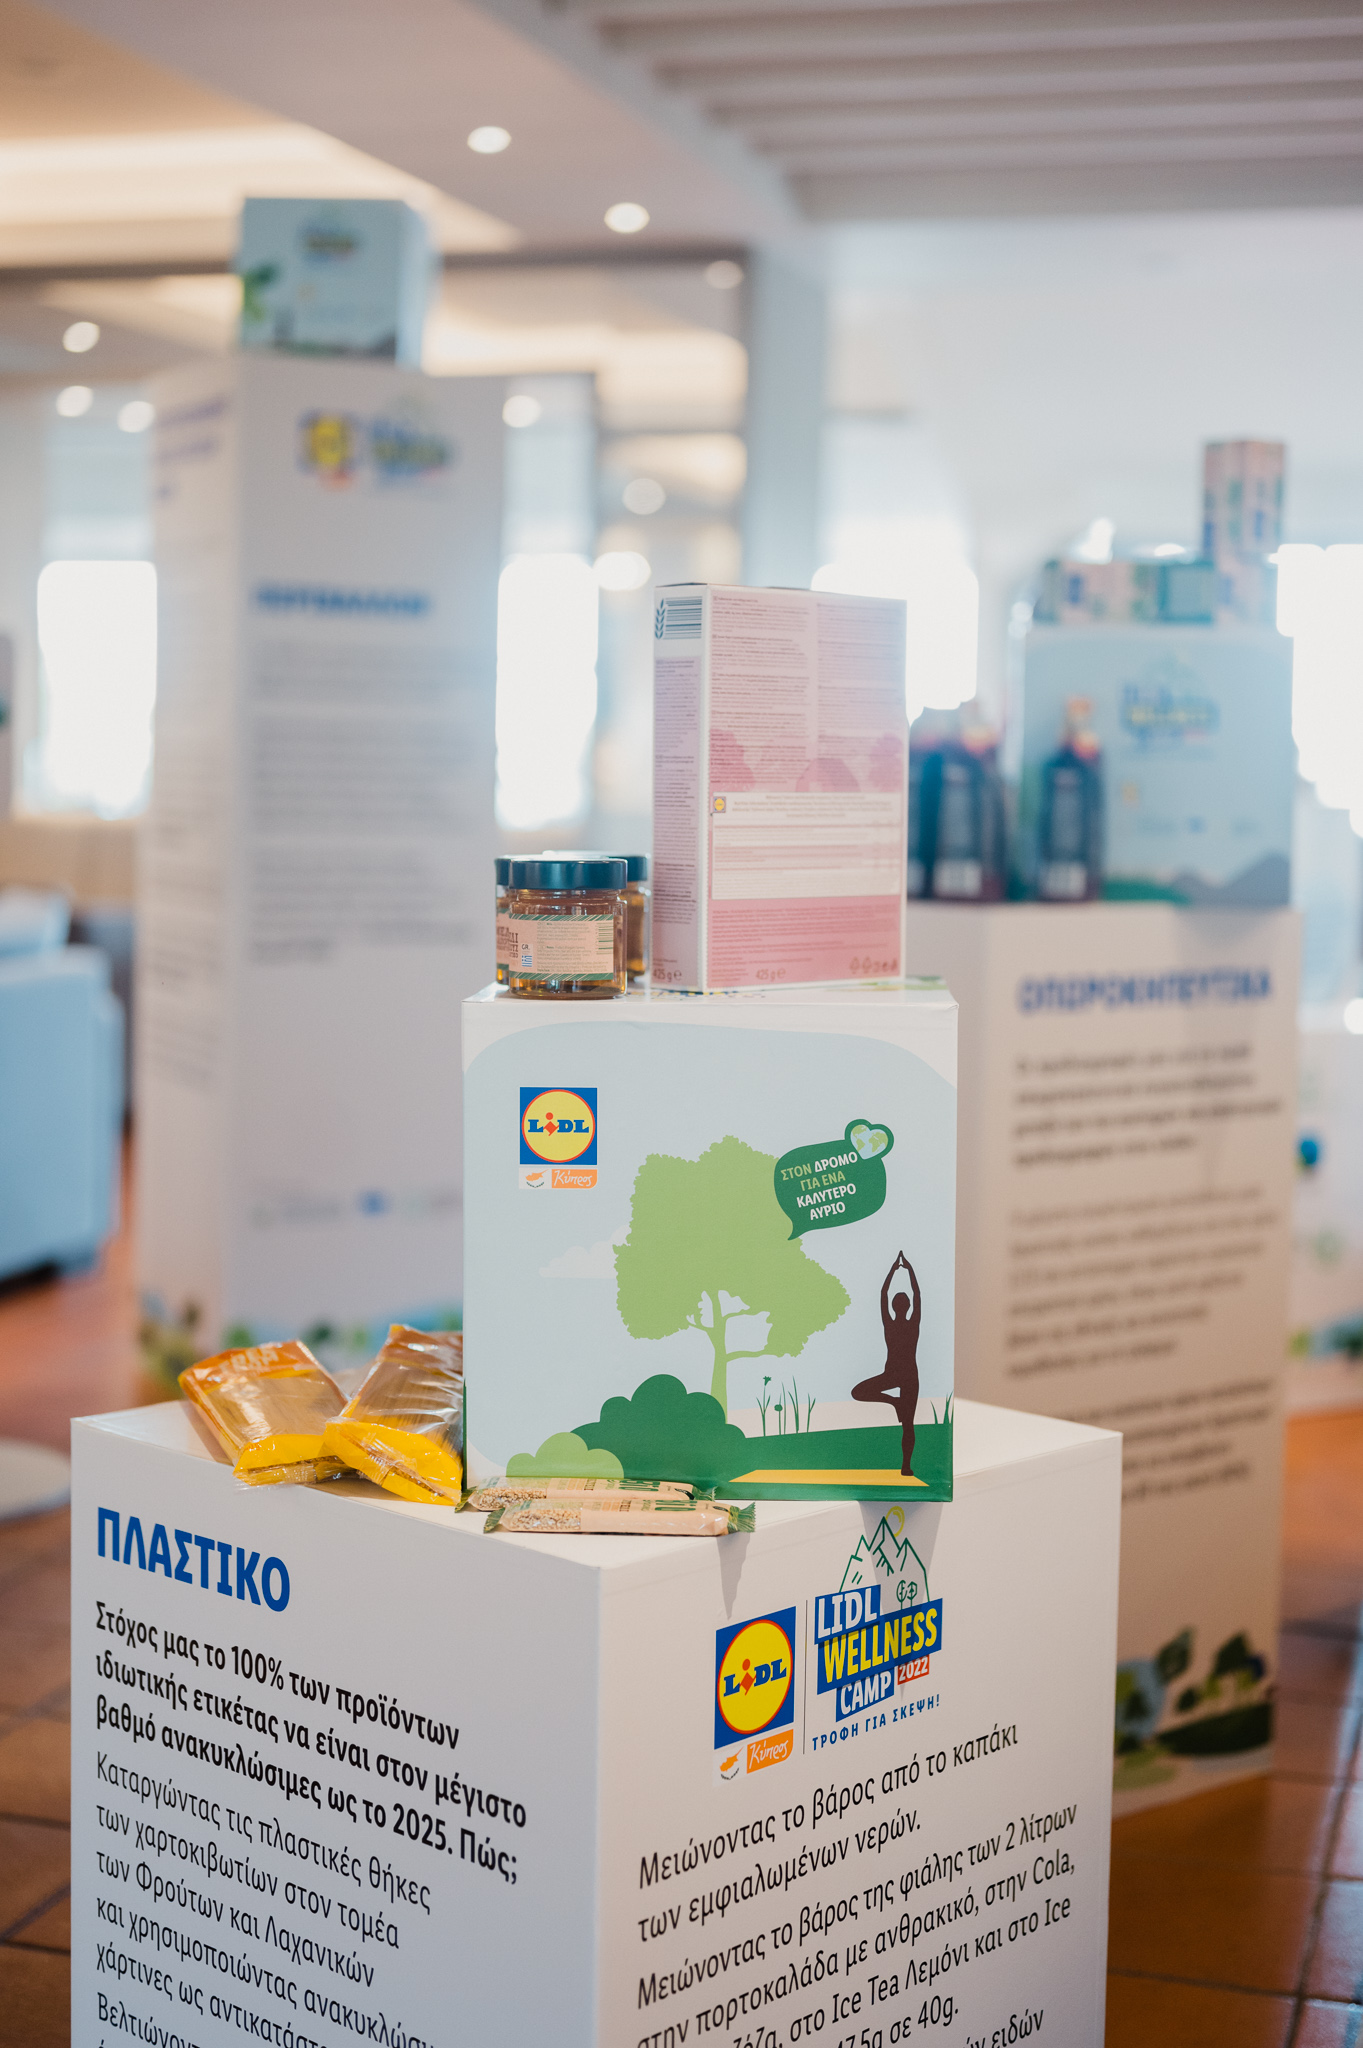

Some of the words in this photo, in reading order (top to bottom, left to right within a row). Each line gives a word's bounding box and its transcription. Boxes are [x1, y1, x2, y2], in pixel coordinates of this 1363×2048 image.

[553, 1170, 593, 1187] Κύπρος
[780, 1163, 812, 1181] ΣΤΟΝ
[814, 1151, 858, 1172] ΔΡΟΜΟ
[796, 1183, 857, 1208] ΚΑΛΥΤΕΡΟ
[800, 1177, 820, 1191] ΓΙΑ
[821, 1170, 846, 1186] ΕΝΑ
[810, 1201, 846, 1220] ΑΥΡΙΟ
[97, 1506, 291, 1612] ΠΛΑΣΤΙΚΟ
[817, 1587, 878, 1639] LIDL
[823, 1608, 938, 1684] WELLNESS
[96, 1601, 158, 1653] Στόχος
[164, 1631, 199, 1667] μας
[204, 1644, 225, 1670] το
[231, 1646, 284, 1690] 100%
[289, 1672, 330, 1705] των
[336, 1688, 459, 1749] προϊόντων
[840, 1670, 892, 1715] CAMP
[898, 1655, 929, 1682] 2022
[96, 1650, 187, 1711] ιδιωτικής
[194, 1689, 278, 1743] ετικέτας
[284, 1720, 310, 1750] να
[316, 1727, 370, 1772] είναι
[376, 1754, 428, 1791] στον
[435, 1772, 526, 1828] μέγιστο
[749, 1739, 789, 1770] Κύπρος
[812, 1723, 859, 1751] ΤΡΟΦΗ
[865, 1713, 887, 1733] ΓΙΑ
[892, 1693, 940, 1723] ΣΚΕΨΗ!
[97, 1694, 155, 1743] βαθμό
[162, 1726, 321, 1809] ανακυκλώσιμες
[328, 1787, 357, 1823] ως
[362, 1799, 386, 1828] το
[393, 1803, 452, 1854] 2025.
[461, 1828, 516, 1885] Πώς;
[98, 1751, 220, 1830] Καταργώντας
[226, 1808, 252, 1843] τις
[258, 1817, 361, 1887] πλαστικές
[369, 1856, 430, 1915] θήκες
[640, 1816, 775, 1889] Μειώνοντας
[782, 1805, 804, 1831] το
[813, 1778, 874, 1830] βάρος
[882, 1753, 919, 1794] από
[926, 1751, 946, 1776] το
[953, 1723, 1018, 1767] καπάκι
[96, 1805, 129, 1835] των
[136, 1821, 278, 1896] χαρτοκιβωτίων
[285, 1882, 331, 1918] στον
[337, 1902, 399, 1949] τομέα
[96, 1851, 130, 1882] των
[136, 1861, 223, 1922] Φρούτων
[230, 1907, 260, 1939] και
[265, 1916, 374, 1987] Λαχανικών
[638, 1905, 681, 1942] των
[689, 1837, 849, 1926] εμφιαλωμένων
[855, 1808, 920, 1853] νερών.
[638, 1934, 765, 2009] Μειώνοντας
[771, 1923, 792, 1949] το
[800, 1895, 858, 1947] βάρος
[863, 1880, 894, 1912] της
[900, 1851, 963, 1901] φιάλης
[968, 1835, 1000, 1866] των
[1006, 1822, 1015, 1851] 2
[1020, 1805, 1077, 1845] λίτρων
[97, 1898, 124, 1928] και
[129, 1912, 297, 2010] χρησιμοποιώντας
[97, 1942, 172, 2001] χάρτινες
[179, 1981, 203, 2015] ως
[696, 1950, 838, 2035] πορτοκαλάδα
[846, 1940, 868, 1976] με
[875, 1886, 979, 1954] ανθρακικό,
[985, 1871, 1027, 1906] στην
[1033, 1849, 1074, 1884] Cola,
[790, 2009, 825, 2042] στο
[832, 1992, 861, 2023] Ice
[868, 1975, 899, 2005] Tea
[905, 1943, 969, 1990] Λεμόνι
[975, 1928, 1002, 1957] και
[1008, 1912, 1038, 1942] στο
[1045, 1898, 1070, 1926] Ice
[890, 2017, 911, 2044] σε
[918, 1995, 958, 2029] 40g.
[992, 2009, 1043, 2048] ειδών
